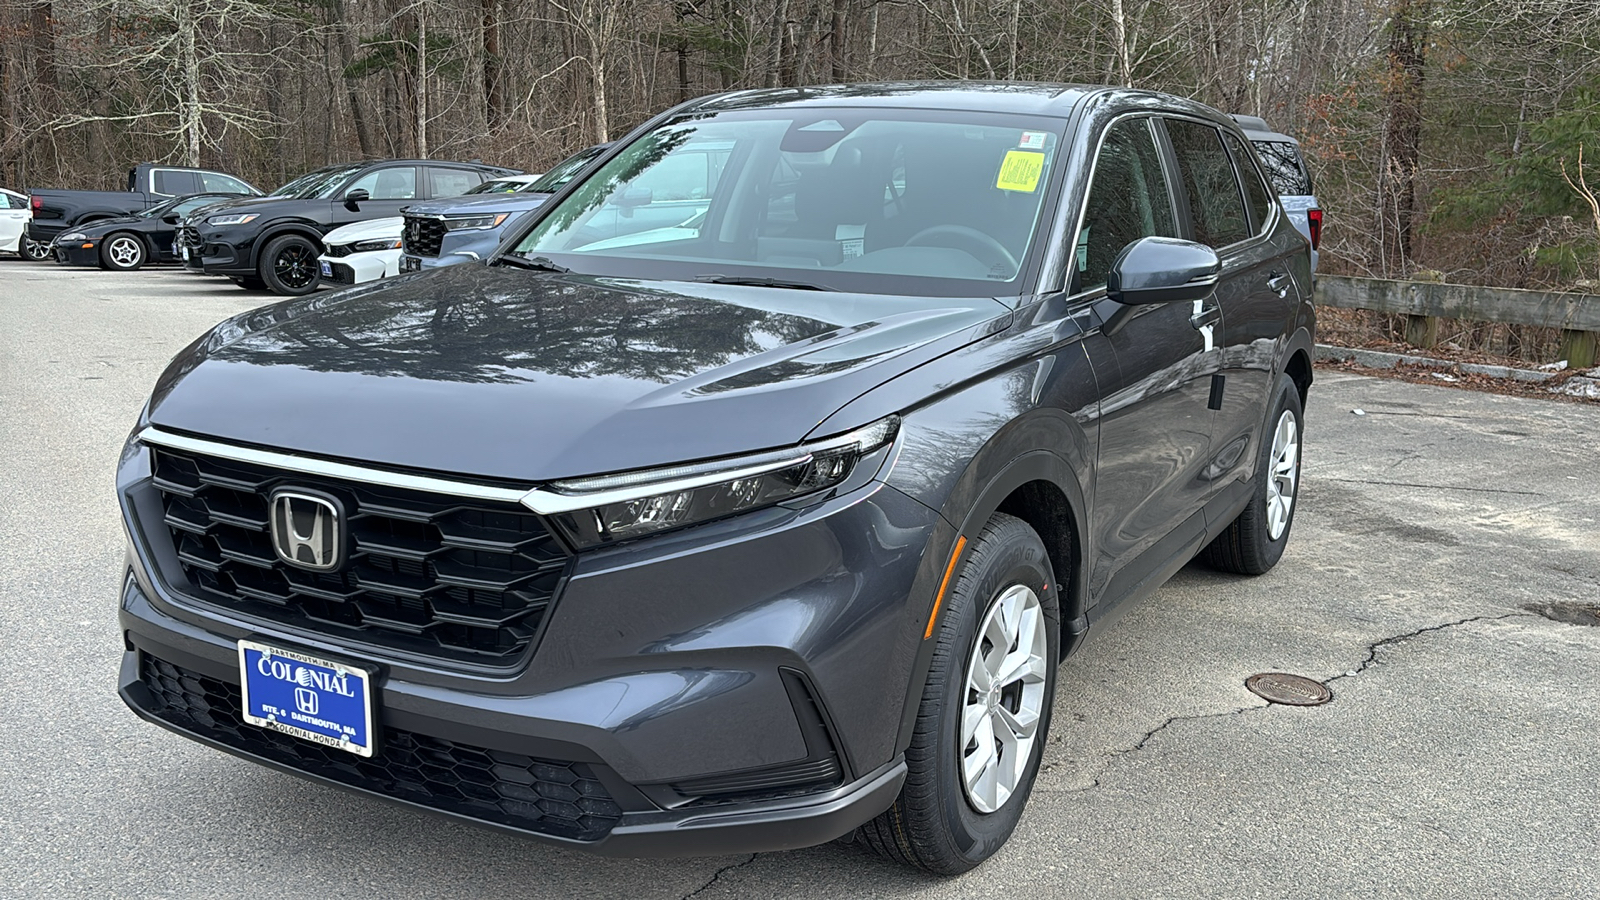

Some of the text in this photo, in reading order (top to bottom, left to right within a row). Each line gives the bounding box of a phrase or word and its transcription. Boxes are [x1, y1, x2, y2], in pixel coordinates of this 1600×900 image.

[1025, 549, 1036, 560] GT
[257, 657, 354, 698] COLONIAL
[323, 661, 335, 669] MA
[262, 704, 356, 736] RTE. 6 DARTMOUTH, MA
[275, 723, 341, 748] COLONIAL HONDA
